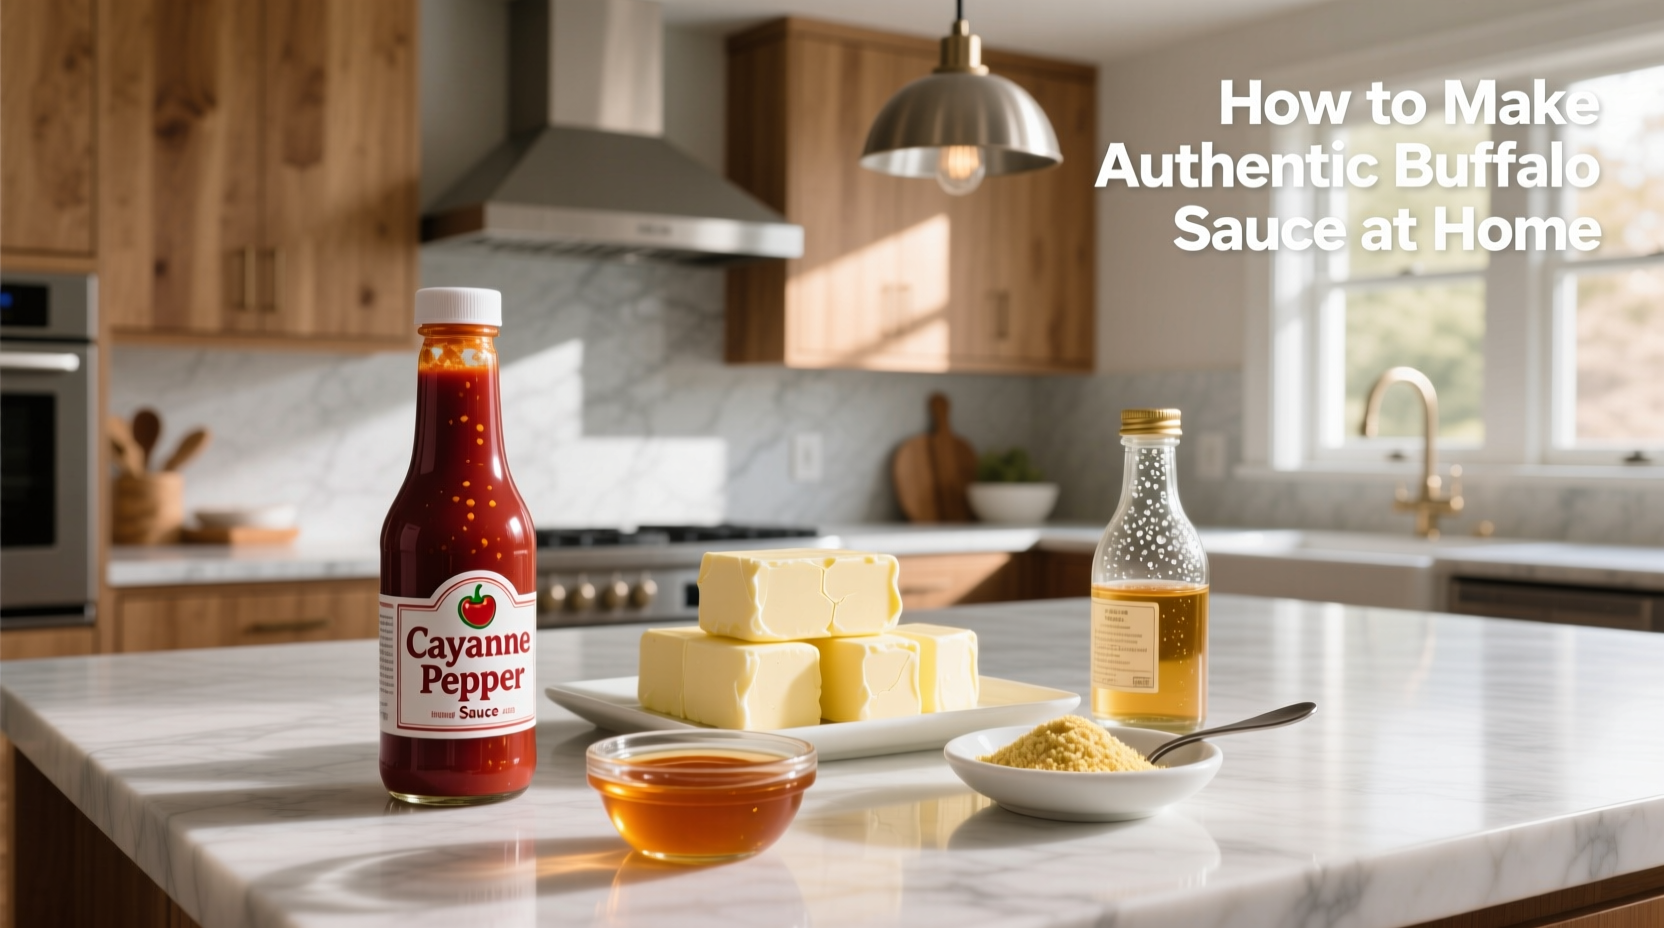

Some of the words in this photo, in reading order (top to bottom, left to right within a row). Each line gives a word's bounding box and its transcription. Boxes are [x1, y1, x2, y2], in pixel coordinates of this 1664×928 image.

[406, 626, 531, 667] Cayanne
[420, 664, 525, 702] Pepper
[459, 706, 499, 719] Sauce
